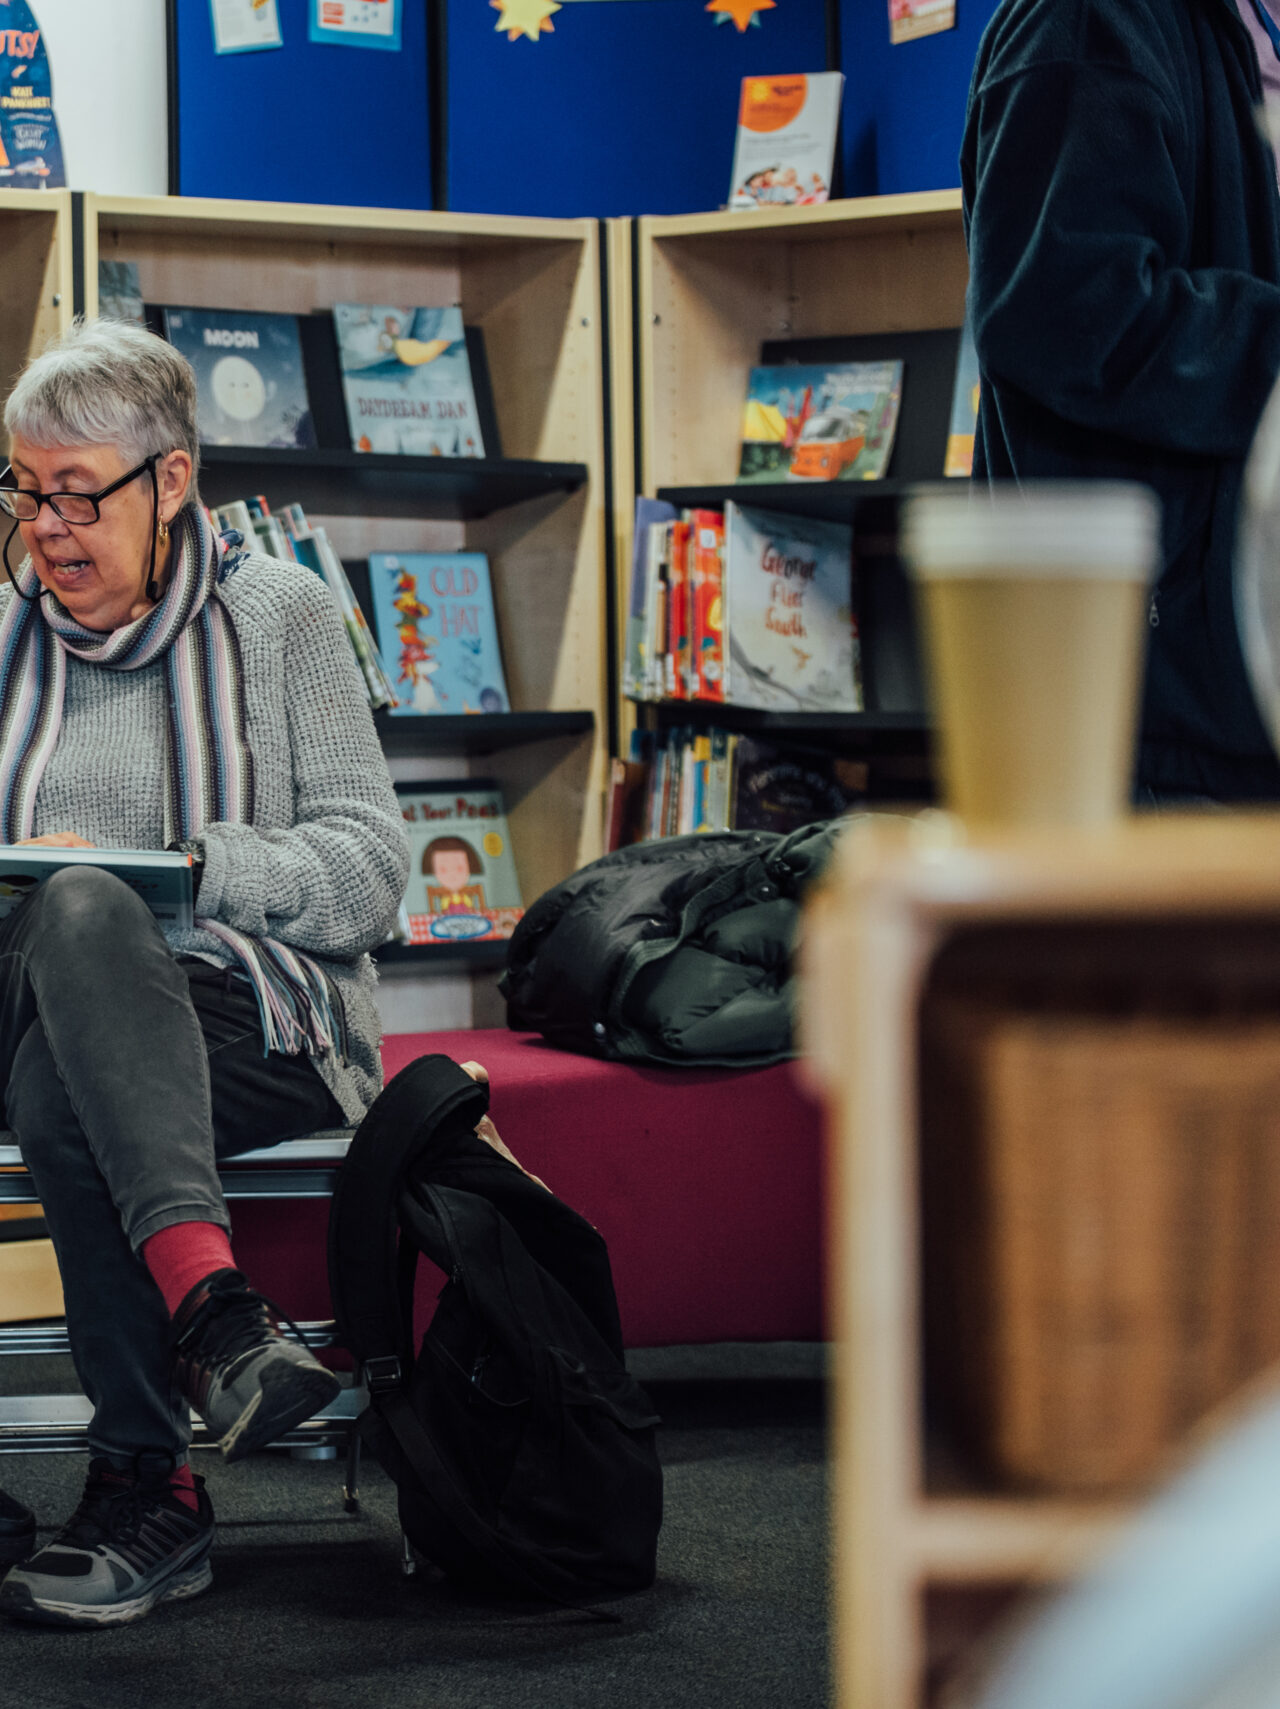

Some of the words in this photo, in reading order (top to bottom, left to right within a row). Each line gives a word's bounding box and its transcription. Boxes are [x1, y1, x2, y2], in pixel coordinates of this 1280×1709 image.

[204, 327, 260, 349] MOON
[357, 396, 433, 419] DAYDREAM
[429, 566, 479, 598] OLD
[439, 602, 484, 638] HAT
